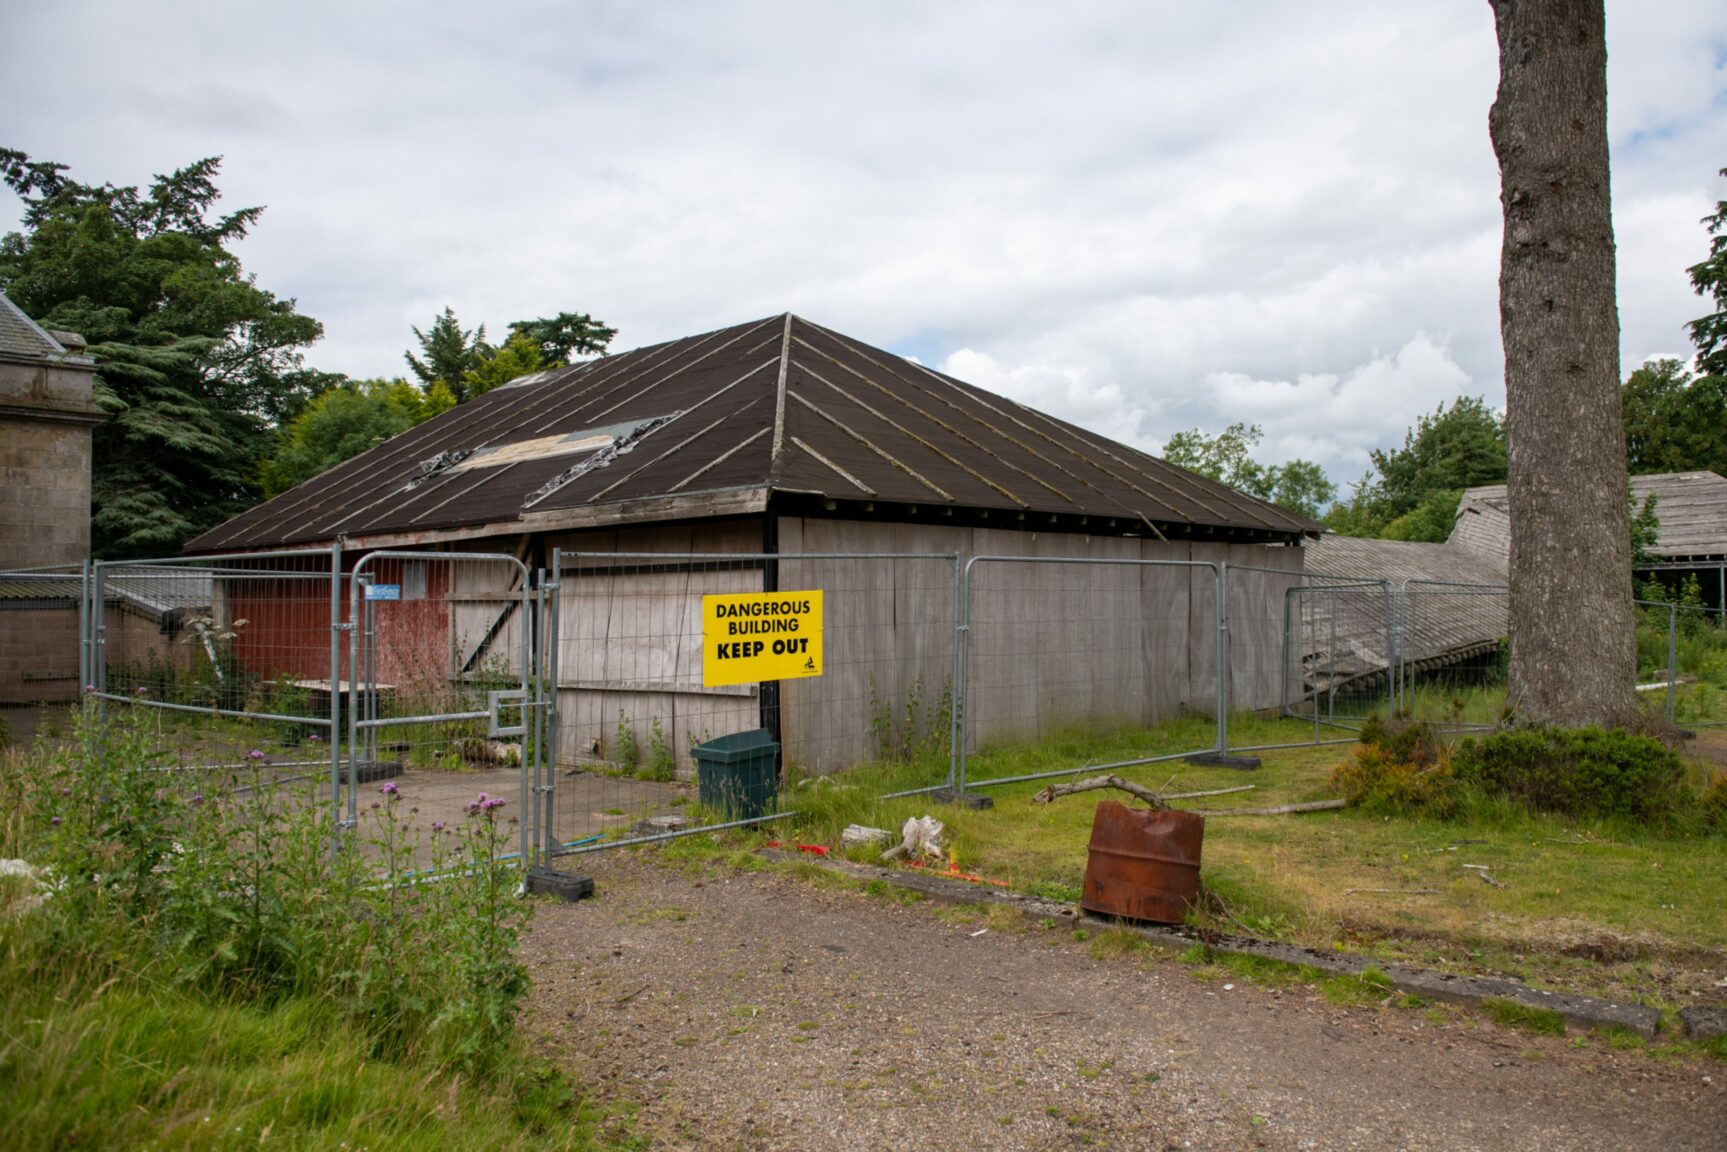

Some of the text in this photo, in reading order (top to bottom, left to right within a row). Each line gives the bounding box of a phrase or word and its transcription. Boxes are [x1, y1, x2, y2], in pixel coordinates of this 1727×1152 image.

[716, 600, 811, 618] DANGEROUS
[728, 618, 800, 636] BUILDING
[717, 638, 809, 660] KEEP OUT
